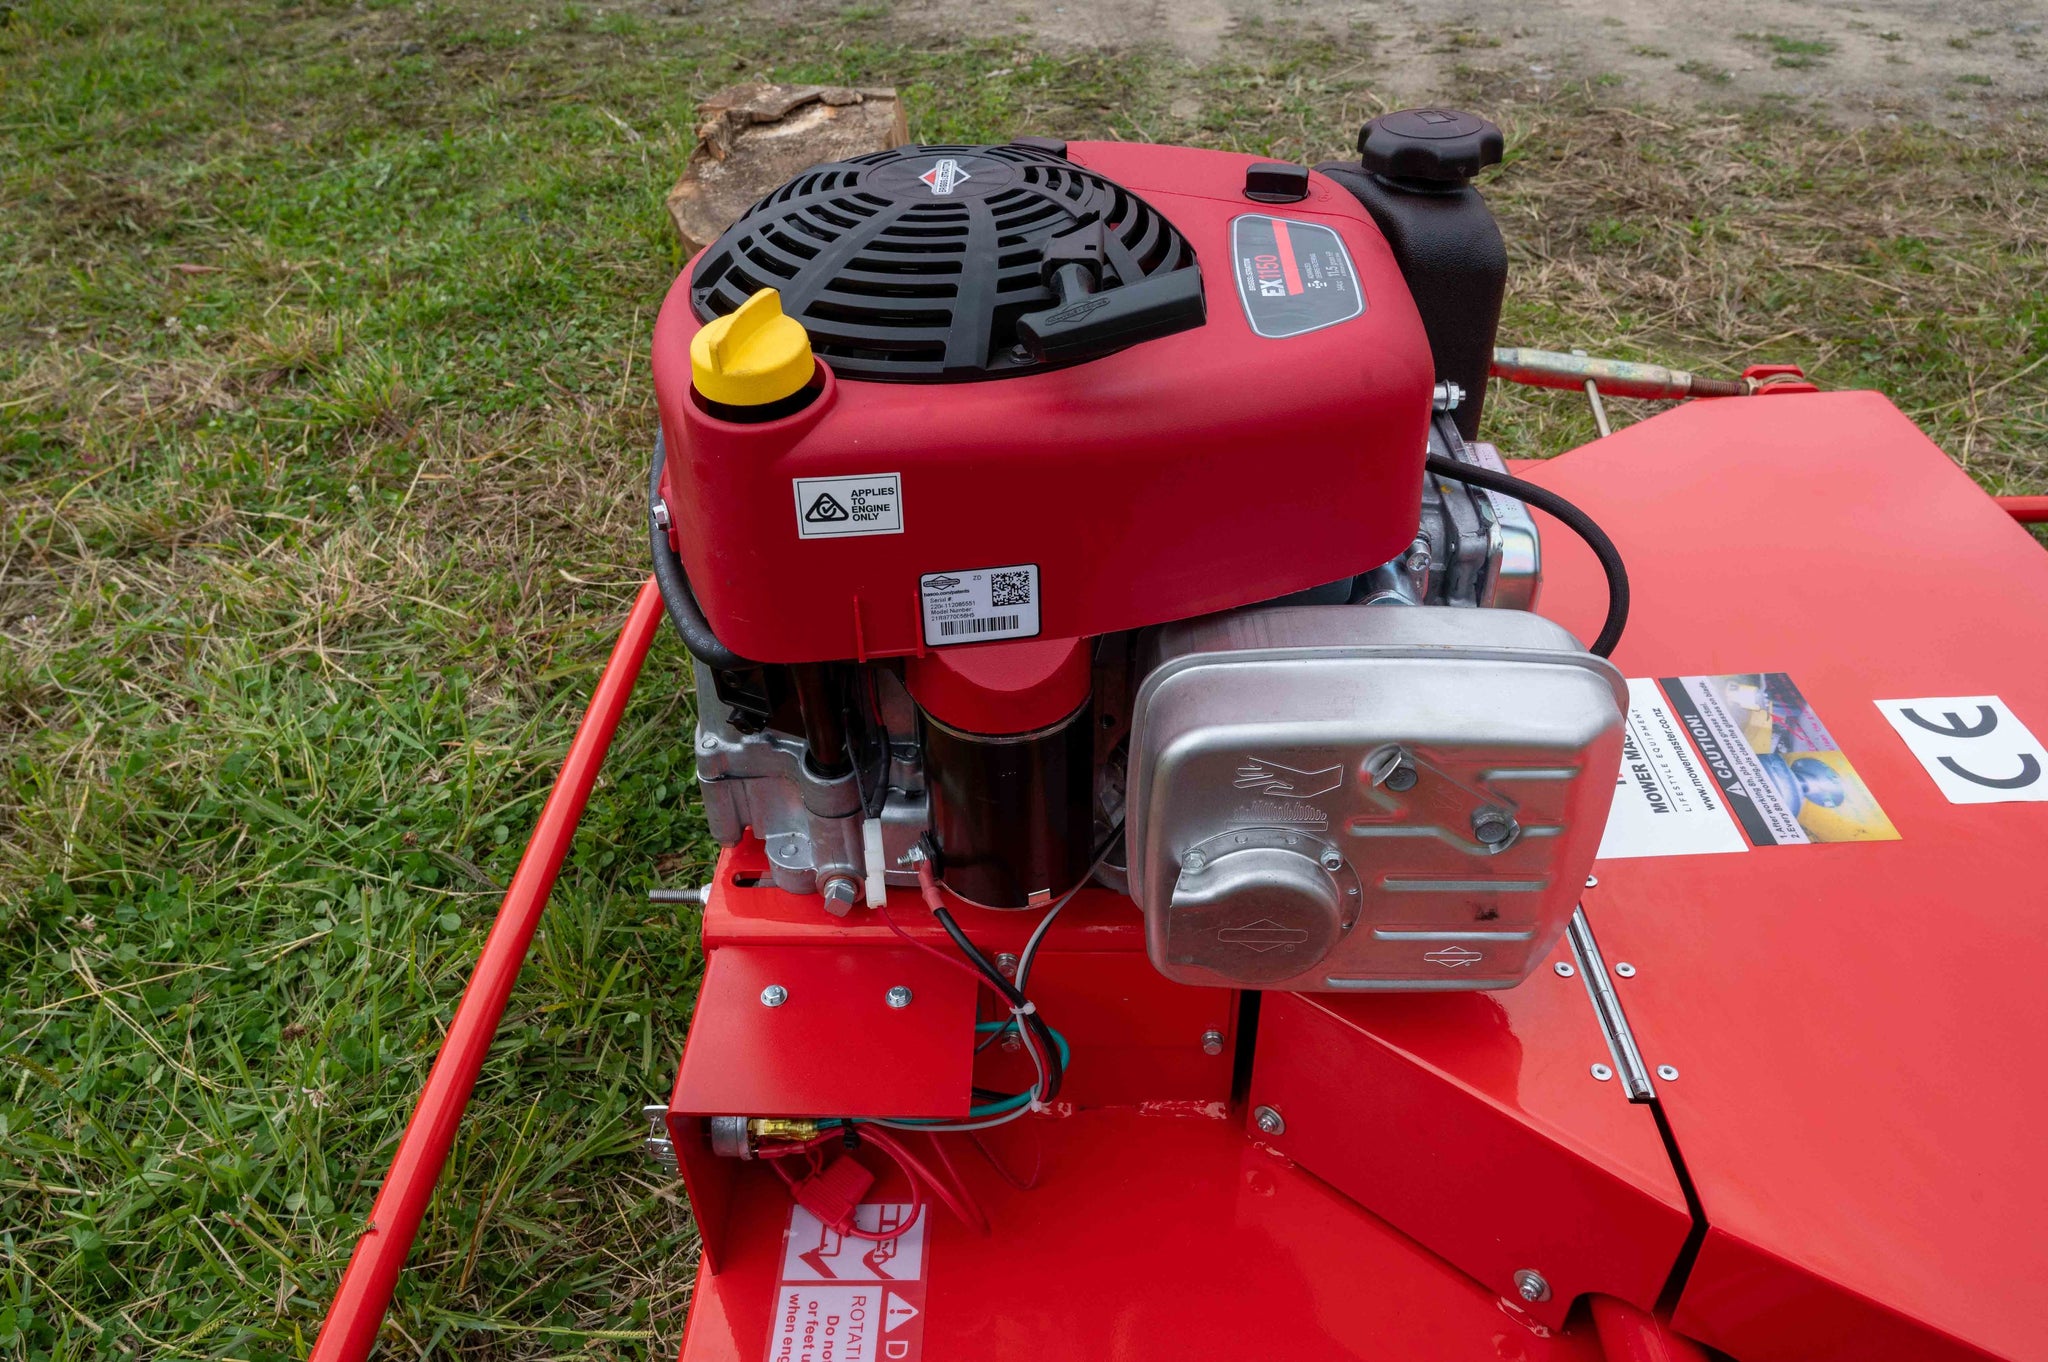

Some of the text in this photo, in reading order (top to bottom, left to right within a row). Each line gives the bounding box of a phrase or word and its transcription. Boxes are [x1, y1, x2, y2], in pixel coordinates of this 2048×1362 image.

[1254, 254, 1286, 297] EX1150
[850, 487, 895, 497] APPLIES
[850, 497, 866, 505] TO
[851, 503, 891, 513] ENGINE
[852, 512, 879, 522] ONLY
[1710, 718, 1728, 738] grease
[1714, 706, 1733, 728] glasses
[1652, 708, 1714, 810] www.mowermaster.co.nz
[1684, 715, 1731, 778] CAUTION!
[1723, 738, 1742, 764] increase
[1734, 739, 1748, 756] clean
[1899, 705, 2041, 790] CE
[1631, 709, 1692, 811] LIFESTYLE EQUIPMENT
[1631, 764, 1668, 813] MOWER
[1752, 787, 1772, 814] working
[784, 1293, 800, 1333] when
[808, 1301, 819, 1317] or
[802, 1320, 819, 1349] feet
[825, 1315, 840, 1336] Do
